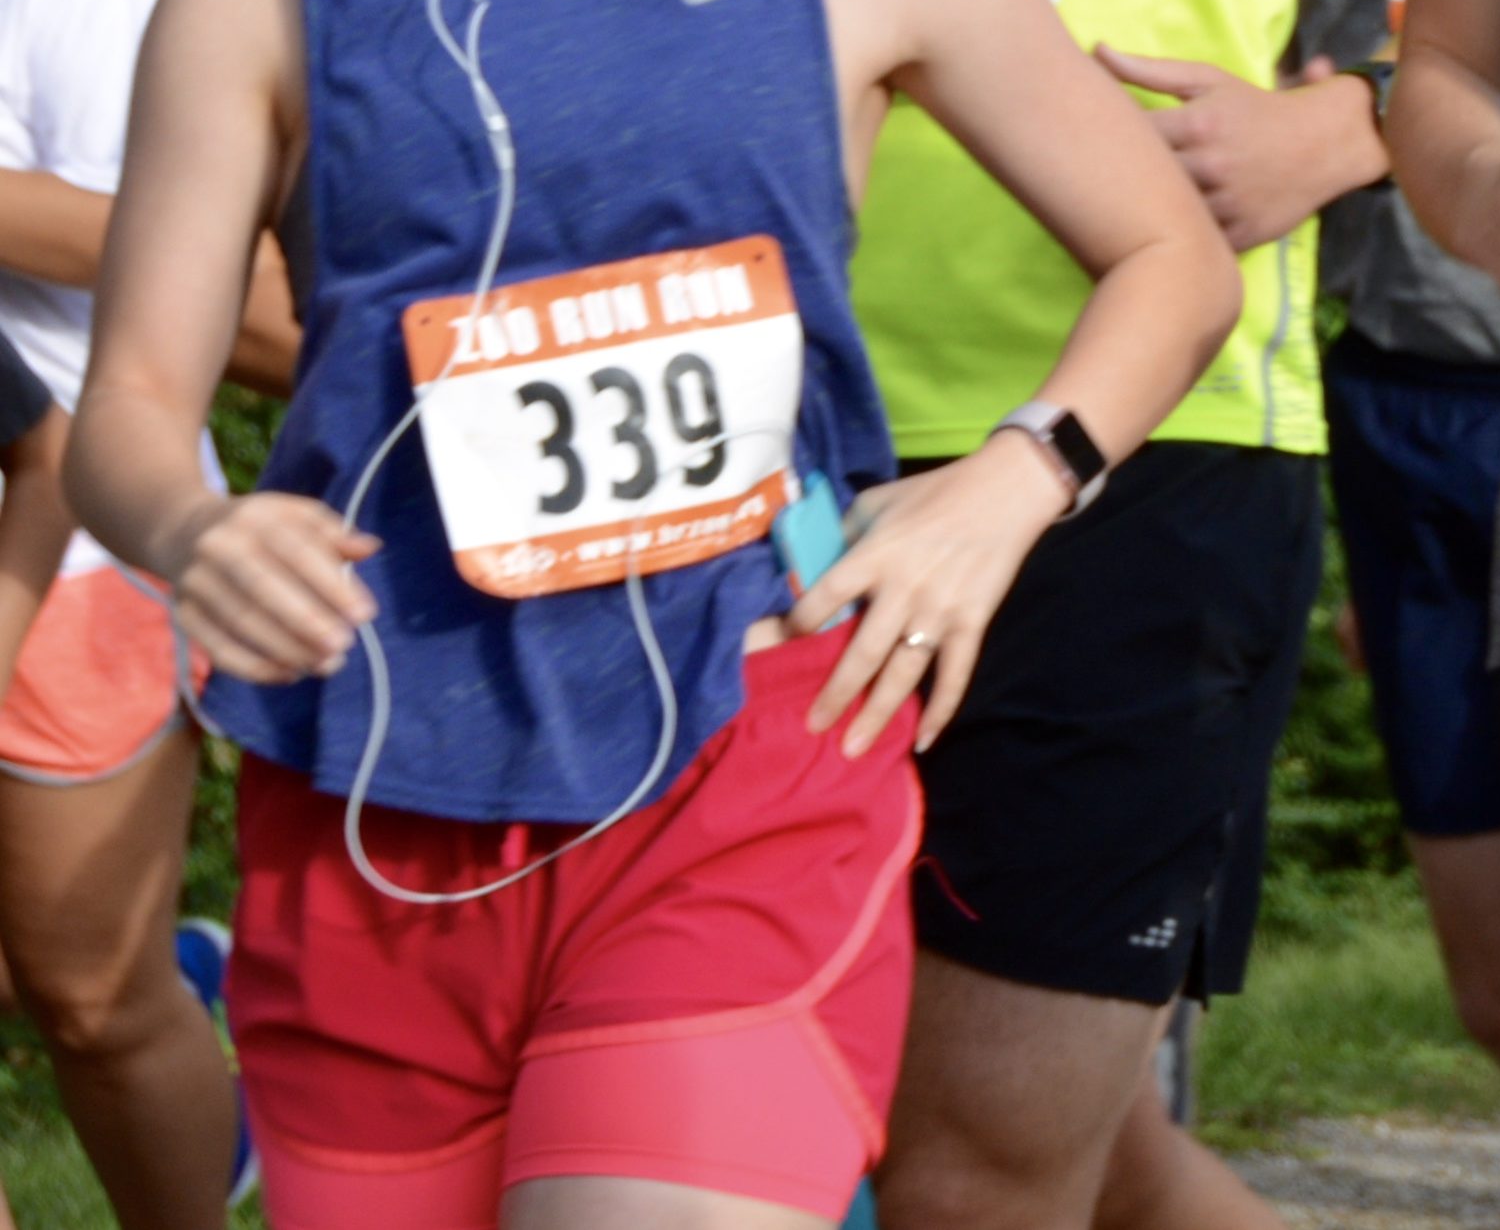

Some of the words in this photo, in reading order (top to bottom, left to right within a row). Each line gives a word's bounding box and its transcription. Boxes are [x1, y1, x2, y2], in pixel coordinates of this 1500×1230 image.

[447, 306, 541, 364] ZOO
[548, 283, 650, 347] RUN
[657, 264, 756, 325] RUN
[514, 352, 727, 516] 339
